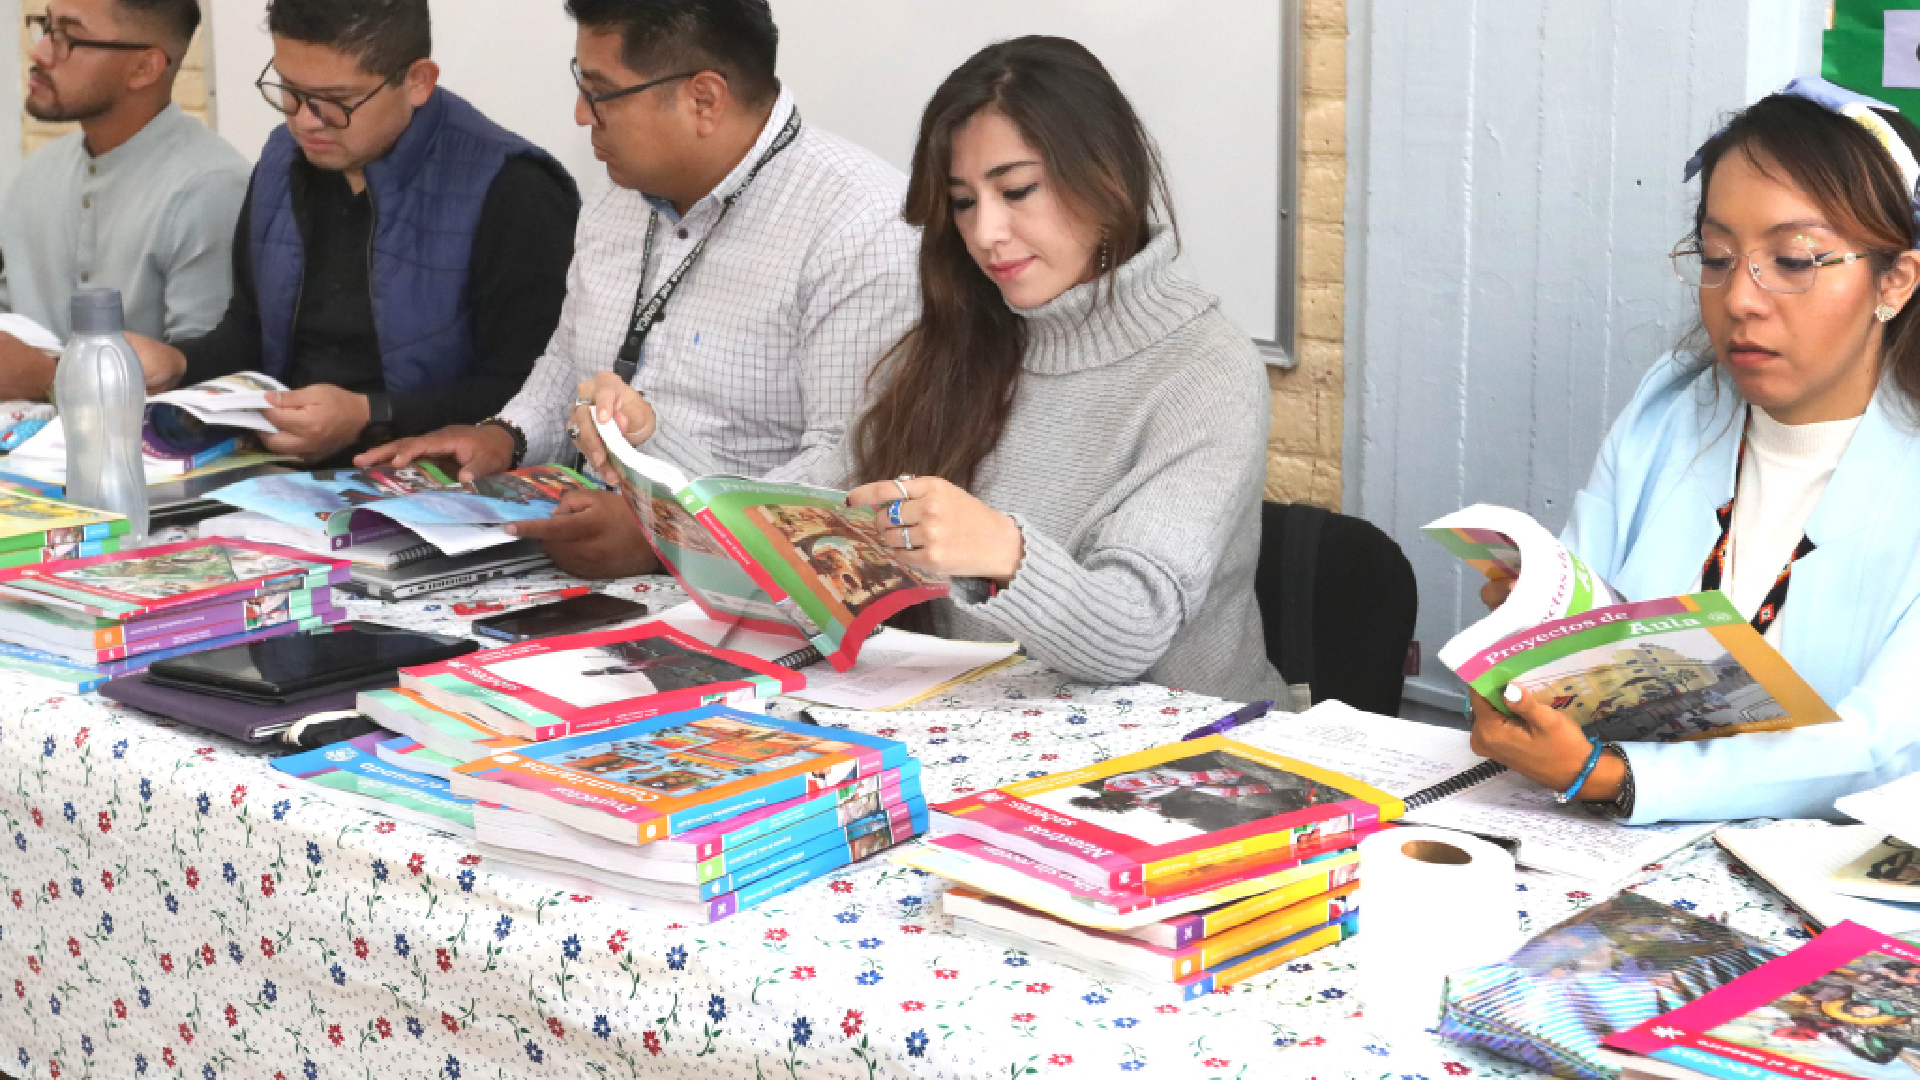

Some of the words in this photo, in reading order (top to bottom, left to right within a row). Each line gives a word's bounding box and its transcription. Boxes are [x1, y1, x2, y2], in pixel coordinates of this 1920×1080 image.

[1483, 617, 1596, 666] Proyectos
[1600, 611, 1628, 626] de
[1628, 616, 1701, 636] Aula
[518, 760, 660, 804] Comunitarios
[550, 786, 638, 814] Proyectos
[1023, 824, 1114, 860] Nuestros
[1668, 1045, 1758, 1080] recetas
[1696, 1039, 1767, 1065] maestro
